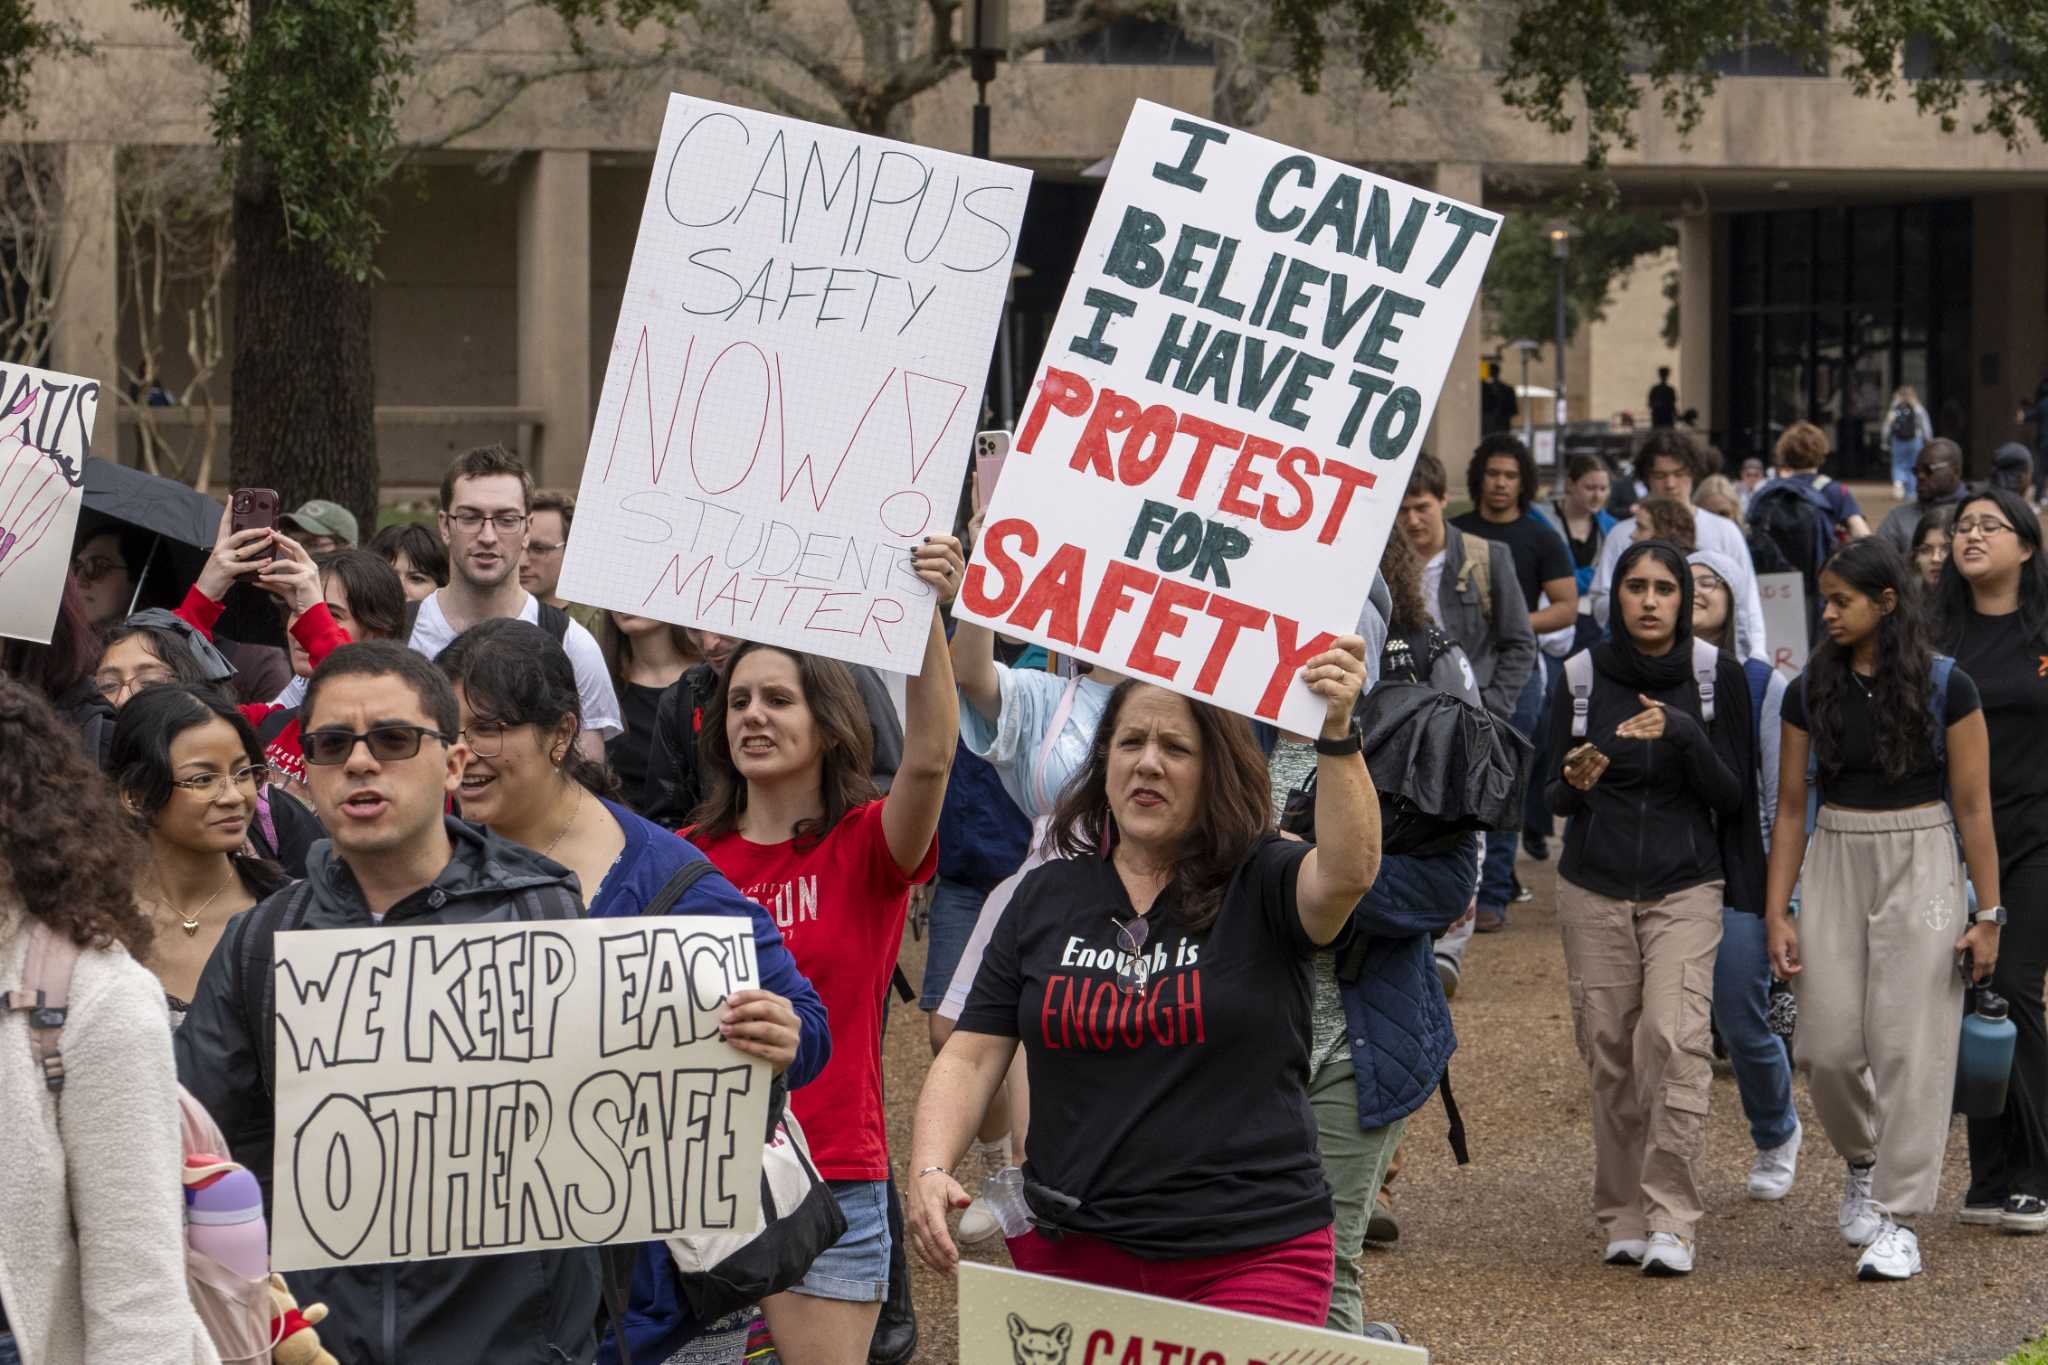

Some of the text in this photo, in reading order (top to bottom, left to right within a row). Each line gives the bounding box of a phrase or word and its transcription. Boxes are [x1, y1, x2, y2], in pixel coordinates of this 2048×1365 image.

[665, 112, 1014, 272] CAMPUS
[1152, 117, 1498, 288] I CAN'T
[681, 247, 937, 336] SAFETY
[1102, 204, 1426, 374] BELIEVE
[603, 325, 968, 537] NOW!
[1068, 287, 1422, 461] I HAVE TO
[1015, 365, 1378, 546] PROTEST
[618, 490, 931, 597] STUDENTS
[642, 553, 905, 654] MATTER
[1123, 498, 1251, 589] FOR
[960, 517, 1339, 722] SAFETY
[274, 939, 396, 1072] WE
[405, 931, 577, 1063] KEEP
[1041, 968, 1206, 1051] ENOUGH
[1060, 935, 1200, 983] Enough is
[293, 1063, 753, 1261] OTHER SAFE
[1083, 1329, 1226, 1365] CAT'
